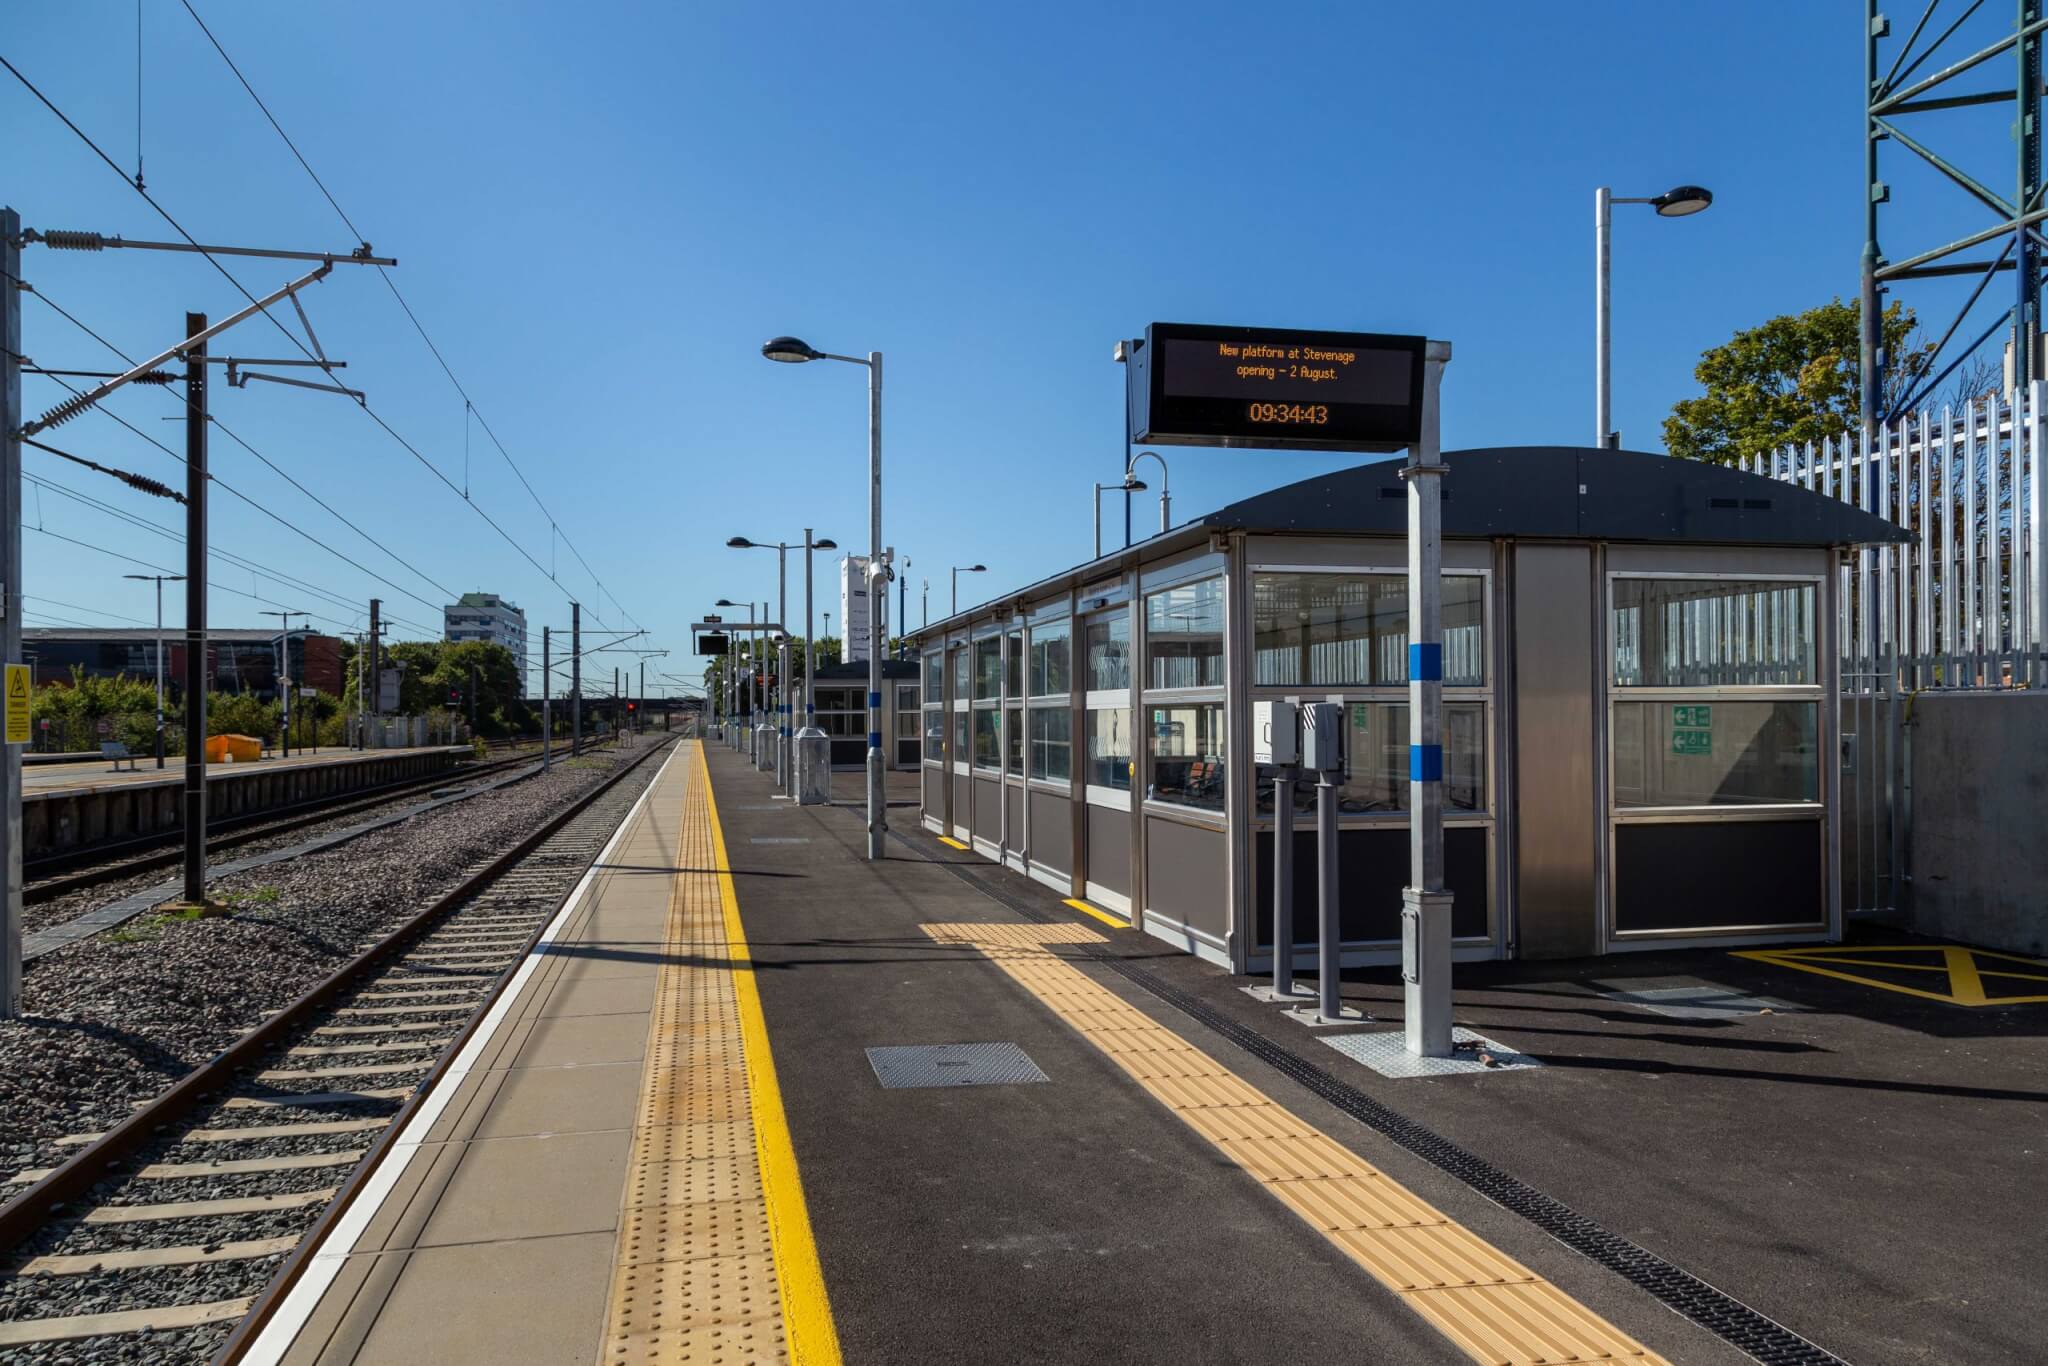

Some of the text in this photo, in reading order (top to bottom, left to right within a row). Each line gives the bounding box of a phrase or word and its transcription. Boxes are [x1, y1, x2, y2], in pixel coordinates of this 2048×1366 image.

[1220, 344, 1355, 364] New platform at Stevenage
[1237, 365, 1275, 380] opening
[1290, 365, 1297, 377] 2
[1300, 366, 1338, 381] August.
[1250, 403, 1328, 424] 09:34:43
